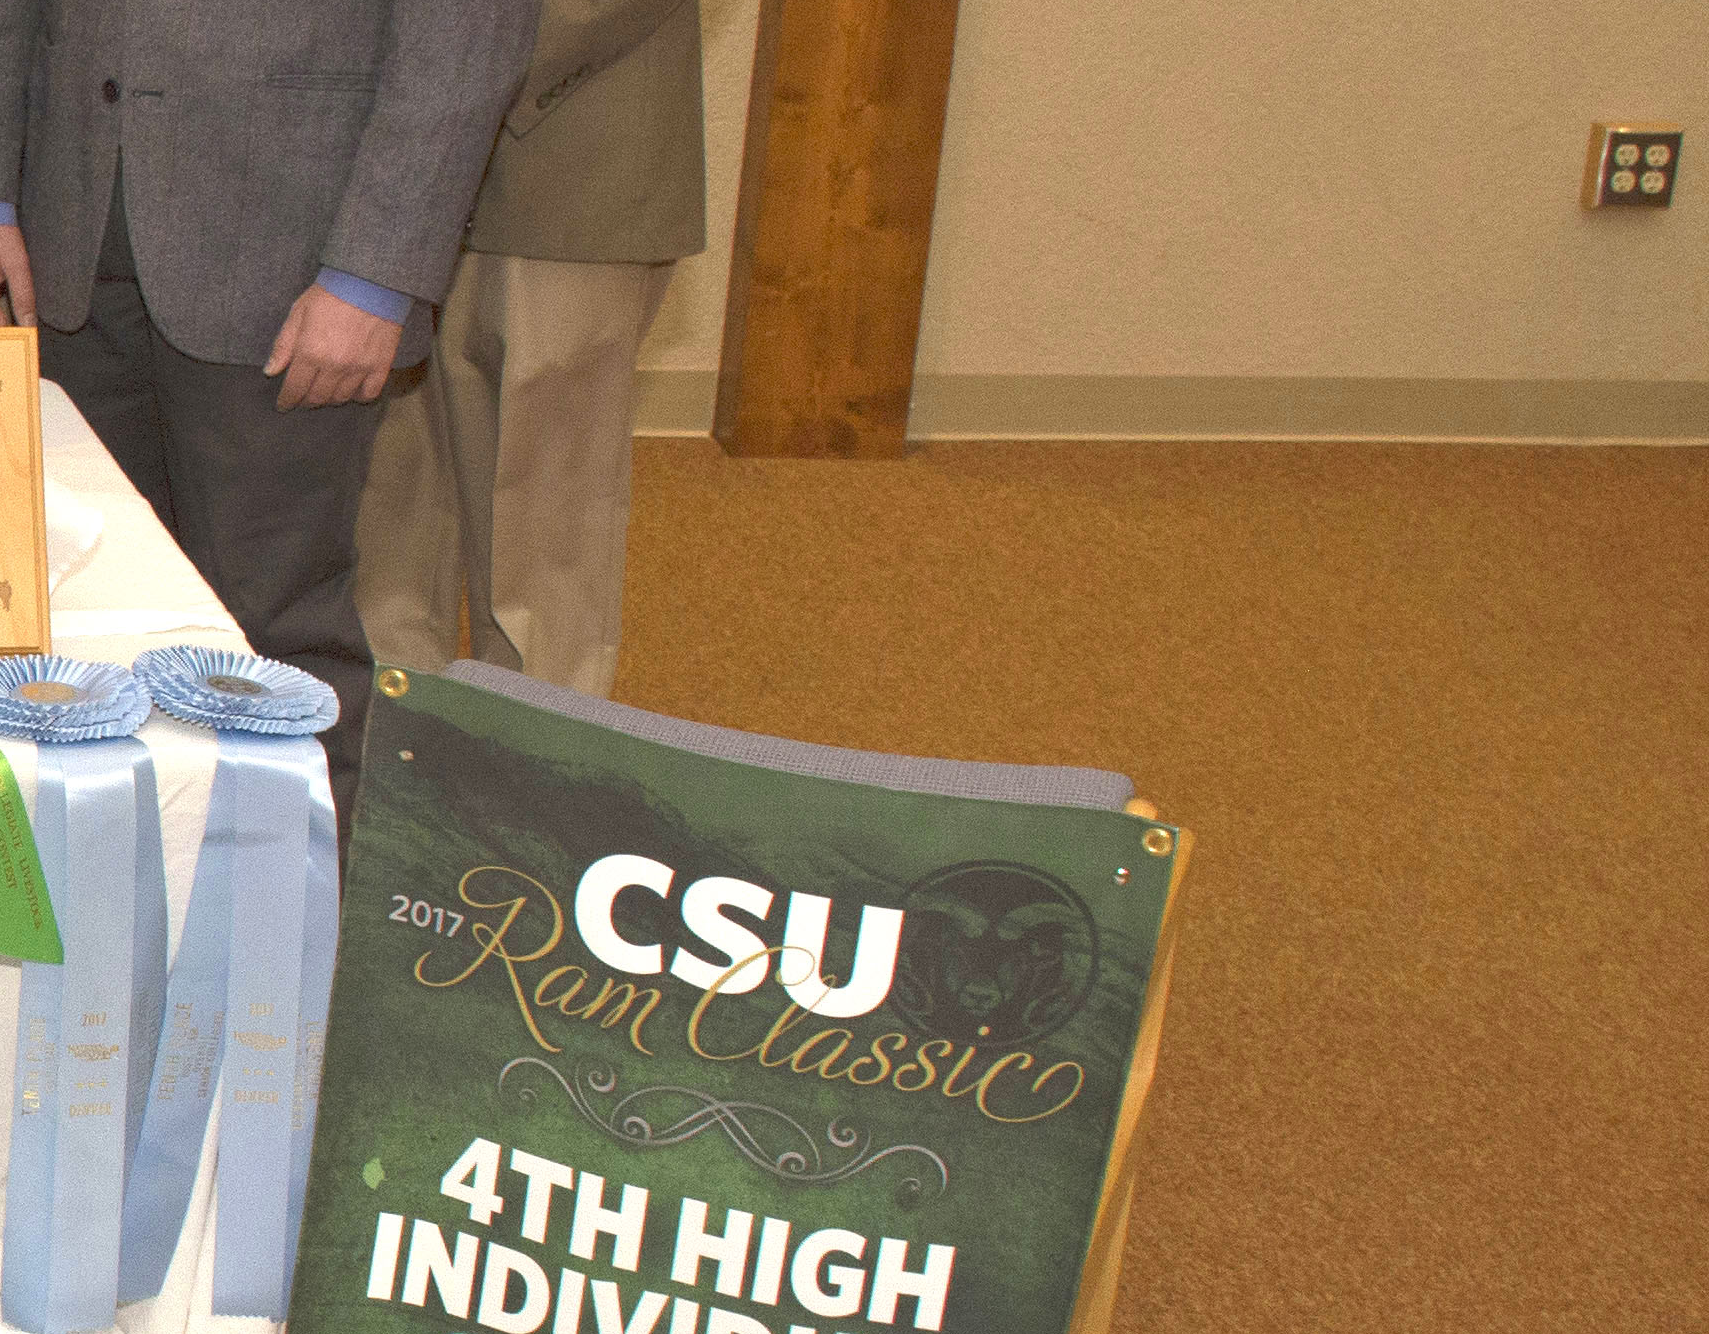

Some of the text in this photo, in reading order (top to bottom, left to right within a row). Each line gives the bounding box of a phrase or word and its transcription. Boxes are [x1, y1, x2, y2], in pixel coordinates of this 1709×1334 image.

[388, 865, 1083, 1122] 2017 Ram Classic
[574, 854, 906, 1019] CSU
[439, 1137, 956, 1331] 4TH HIGH
